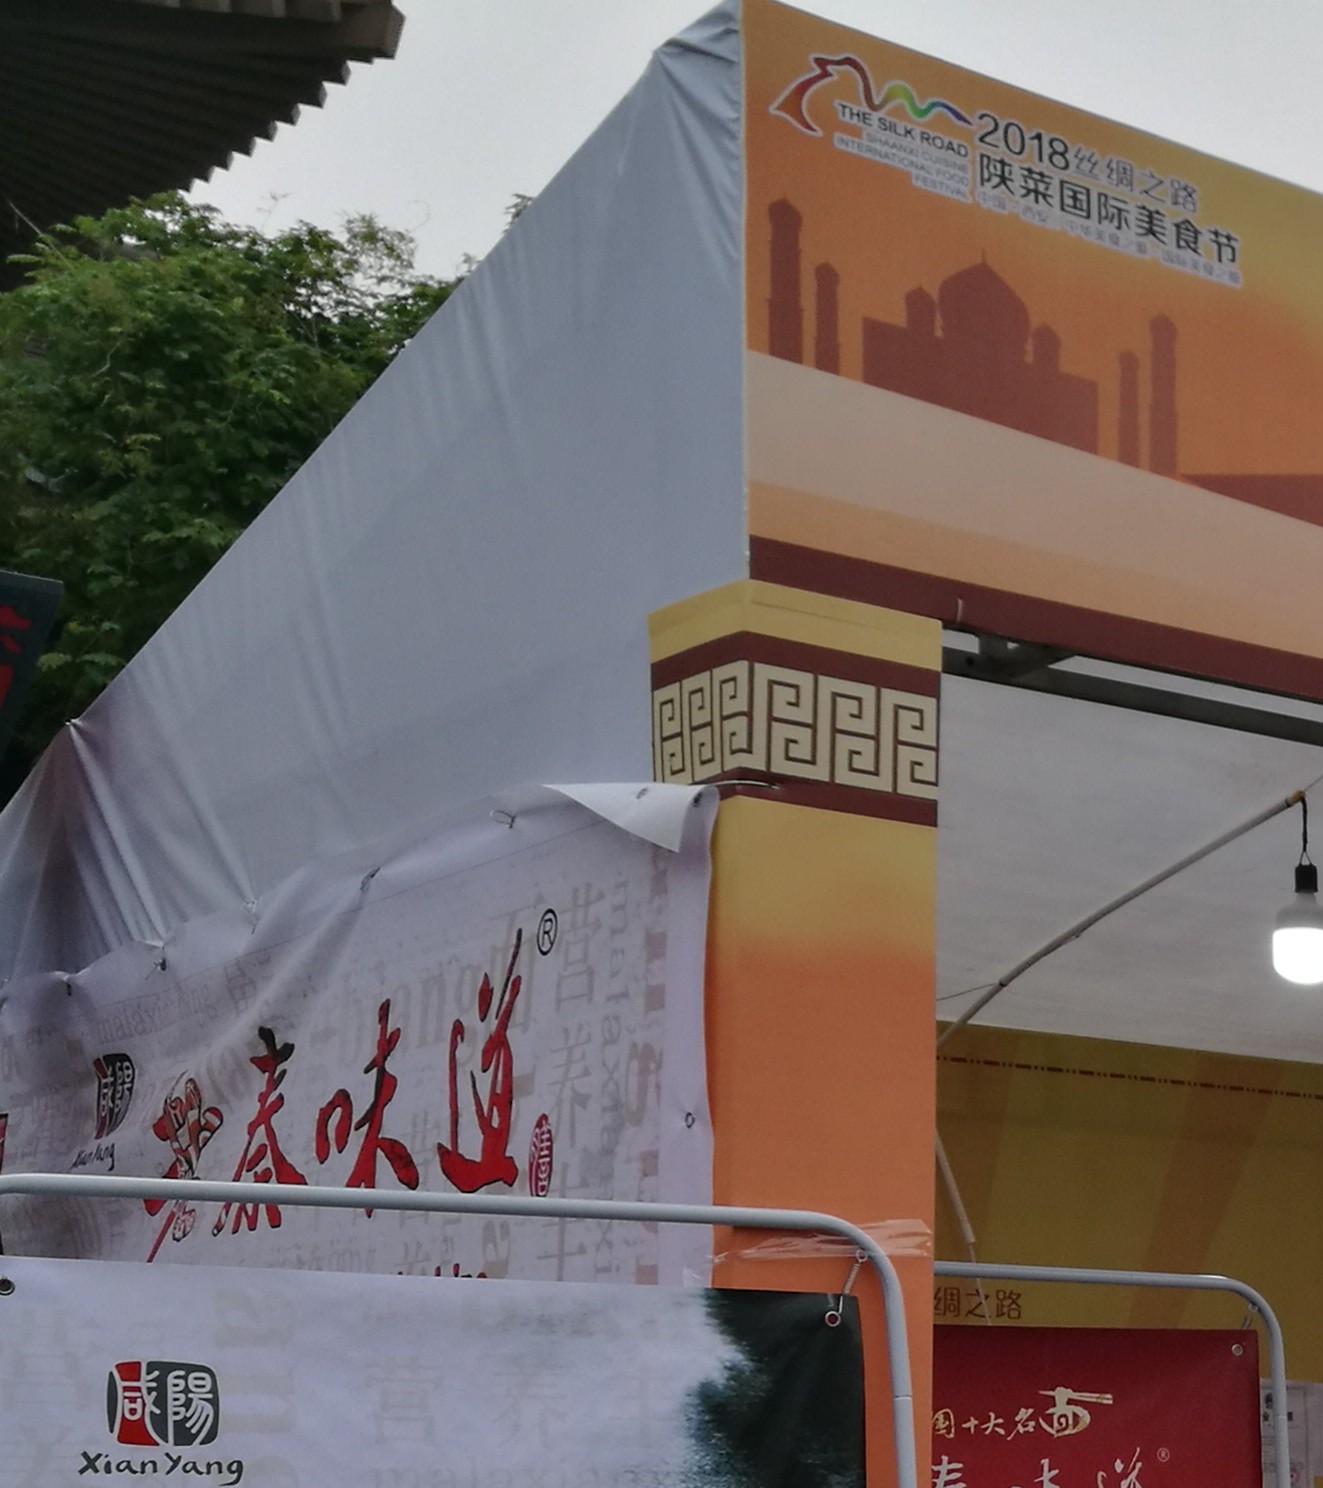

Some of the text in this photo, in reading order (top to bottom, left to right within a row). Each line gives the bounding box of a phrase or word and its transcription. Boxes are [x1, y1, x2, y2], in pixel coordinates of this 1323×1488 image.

[838, 103, 969, 158] THE SILK ROAD
[977, 112, 1200, 214] 2018丝绸之路
[978, 152, 1240, 265] 陕菜国际美食节
